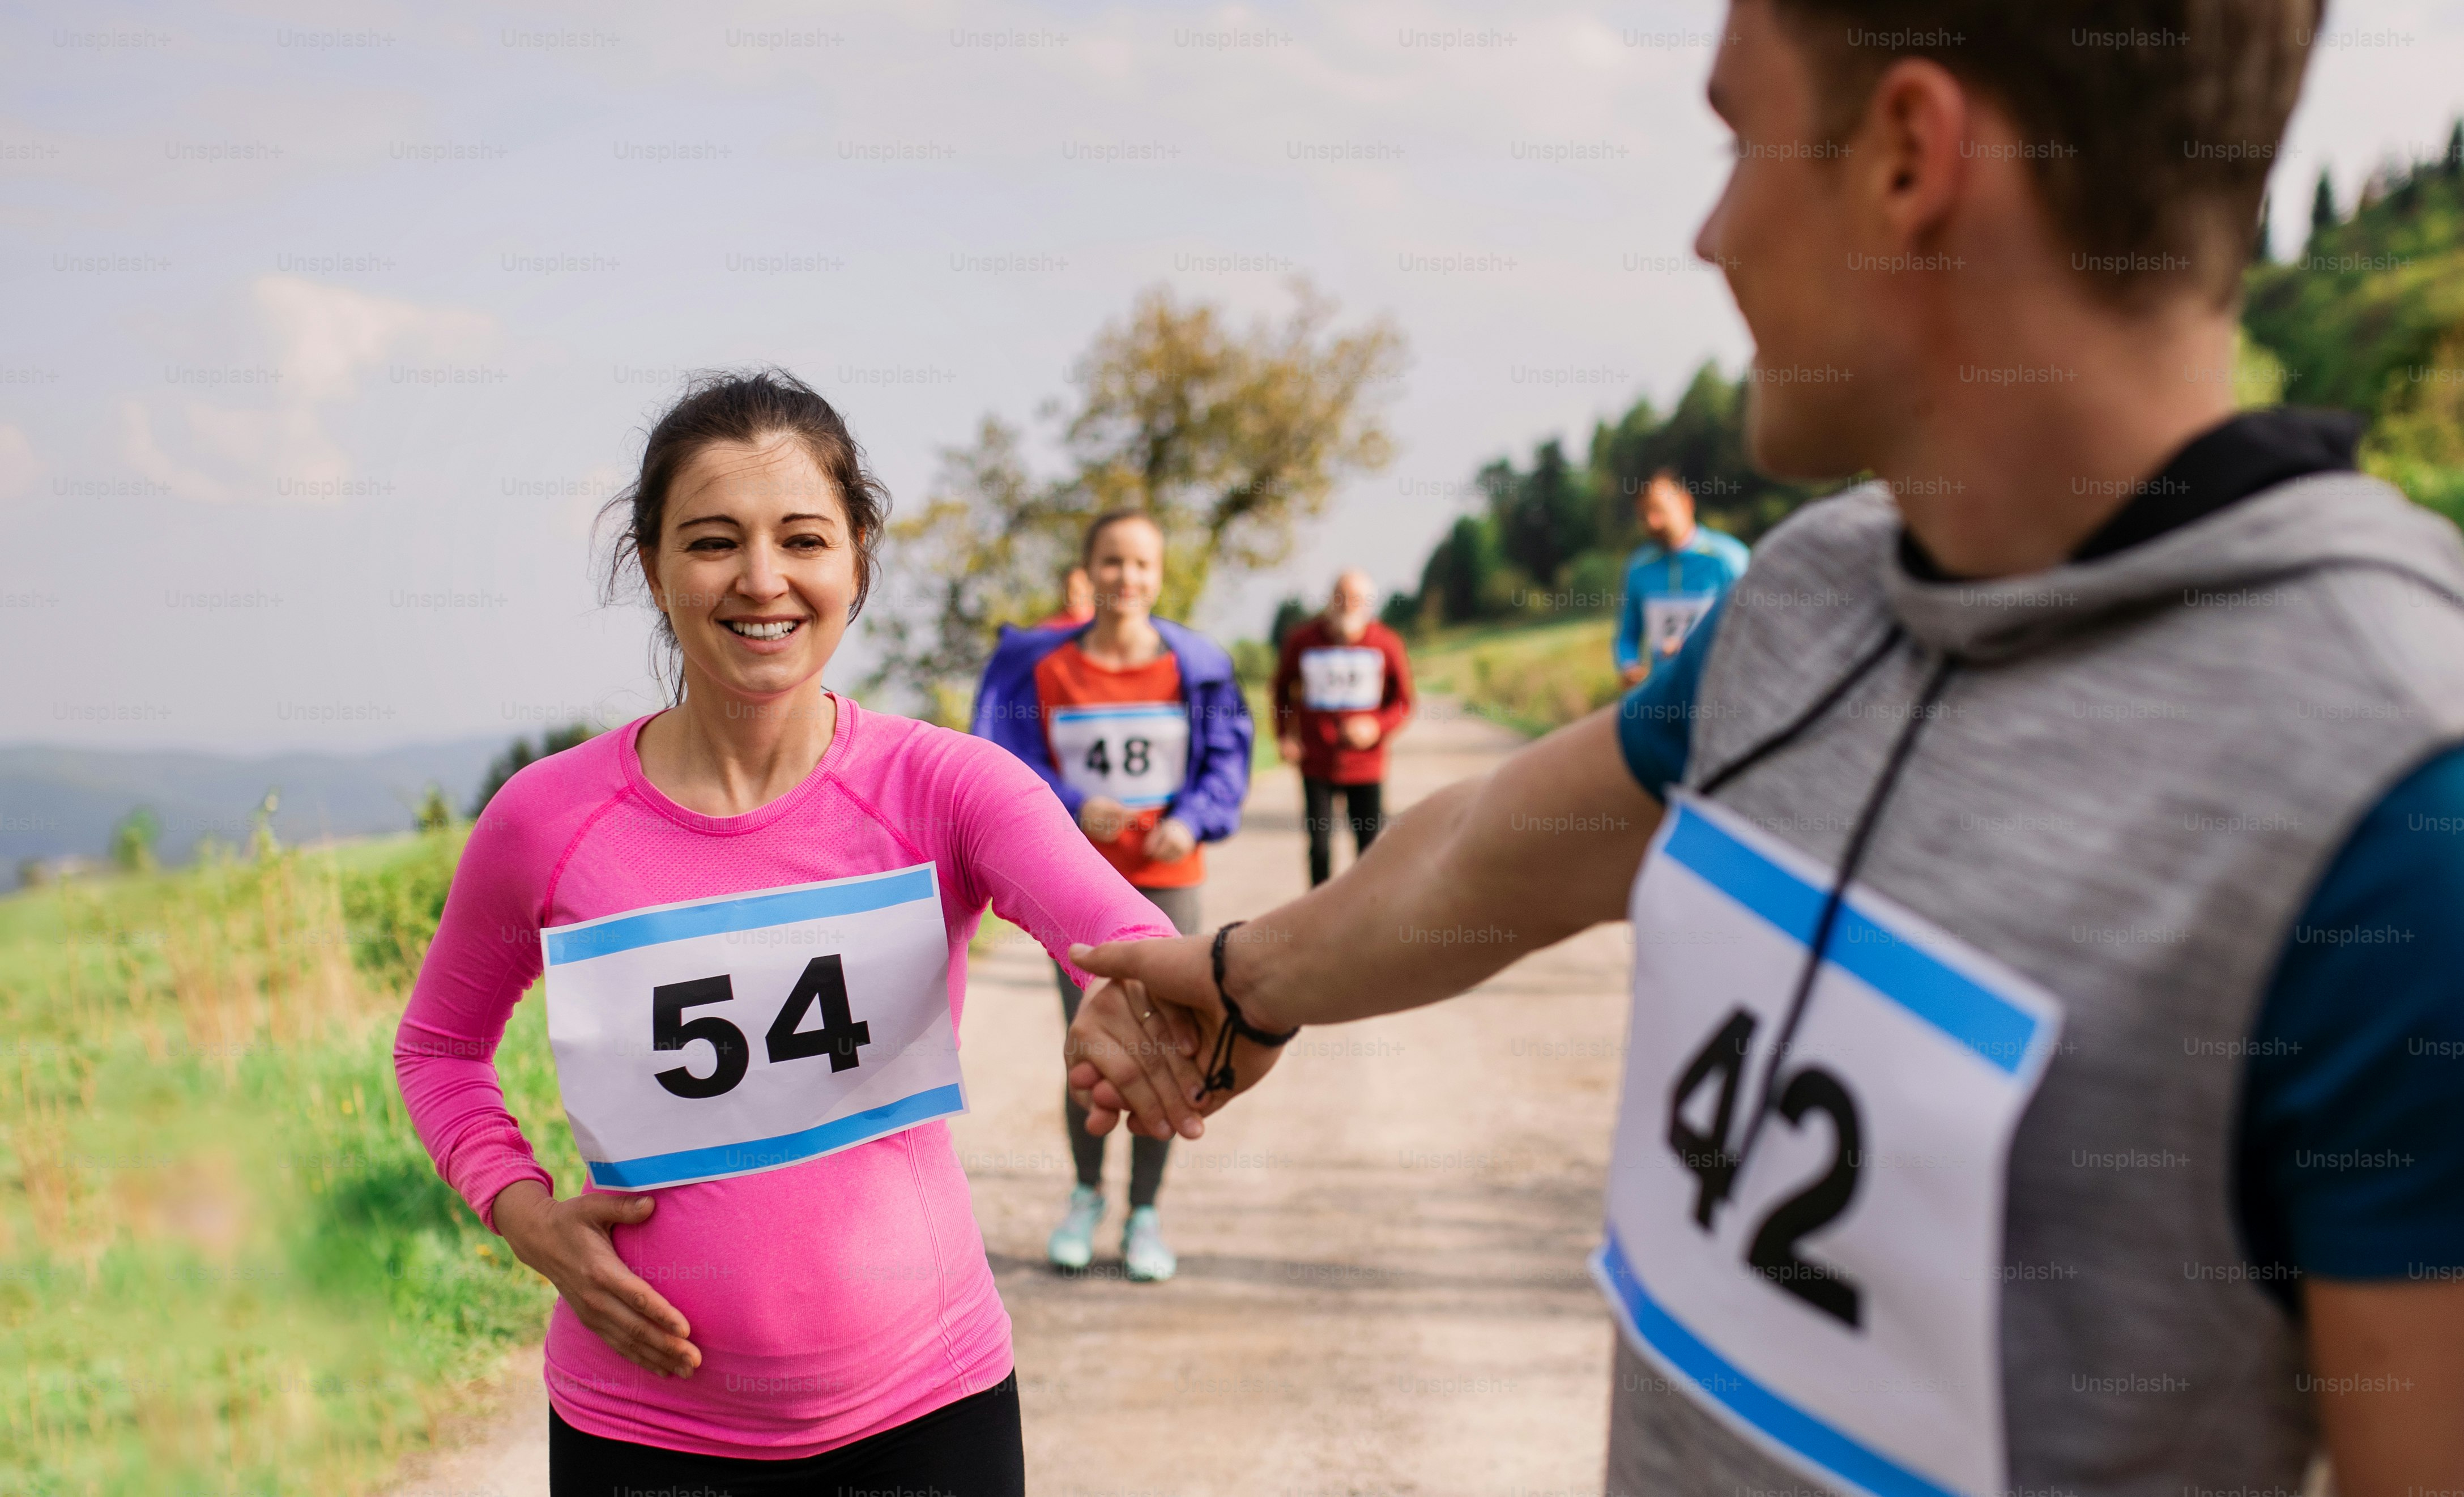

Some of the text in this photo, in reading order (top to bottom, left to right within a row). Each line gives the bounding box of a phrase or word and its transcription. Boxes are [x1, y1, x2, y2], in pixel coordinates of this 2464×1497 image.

[1085, 737, 1151, 778] 48
[654, 954, 870, 1099] 54
[1666, 1008, 1861, 1326] 42
